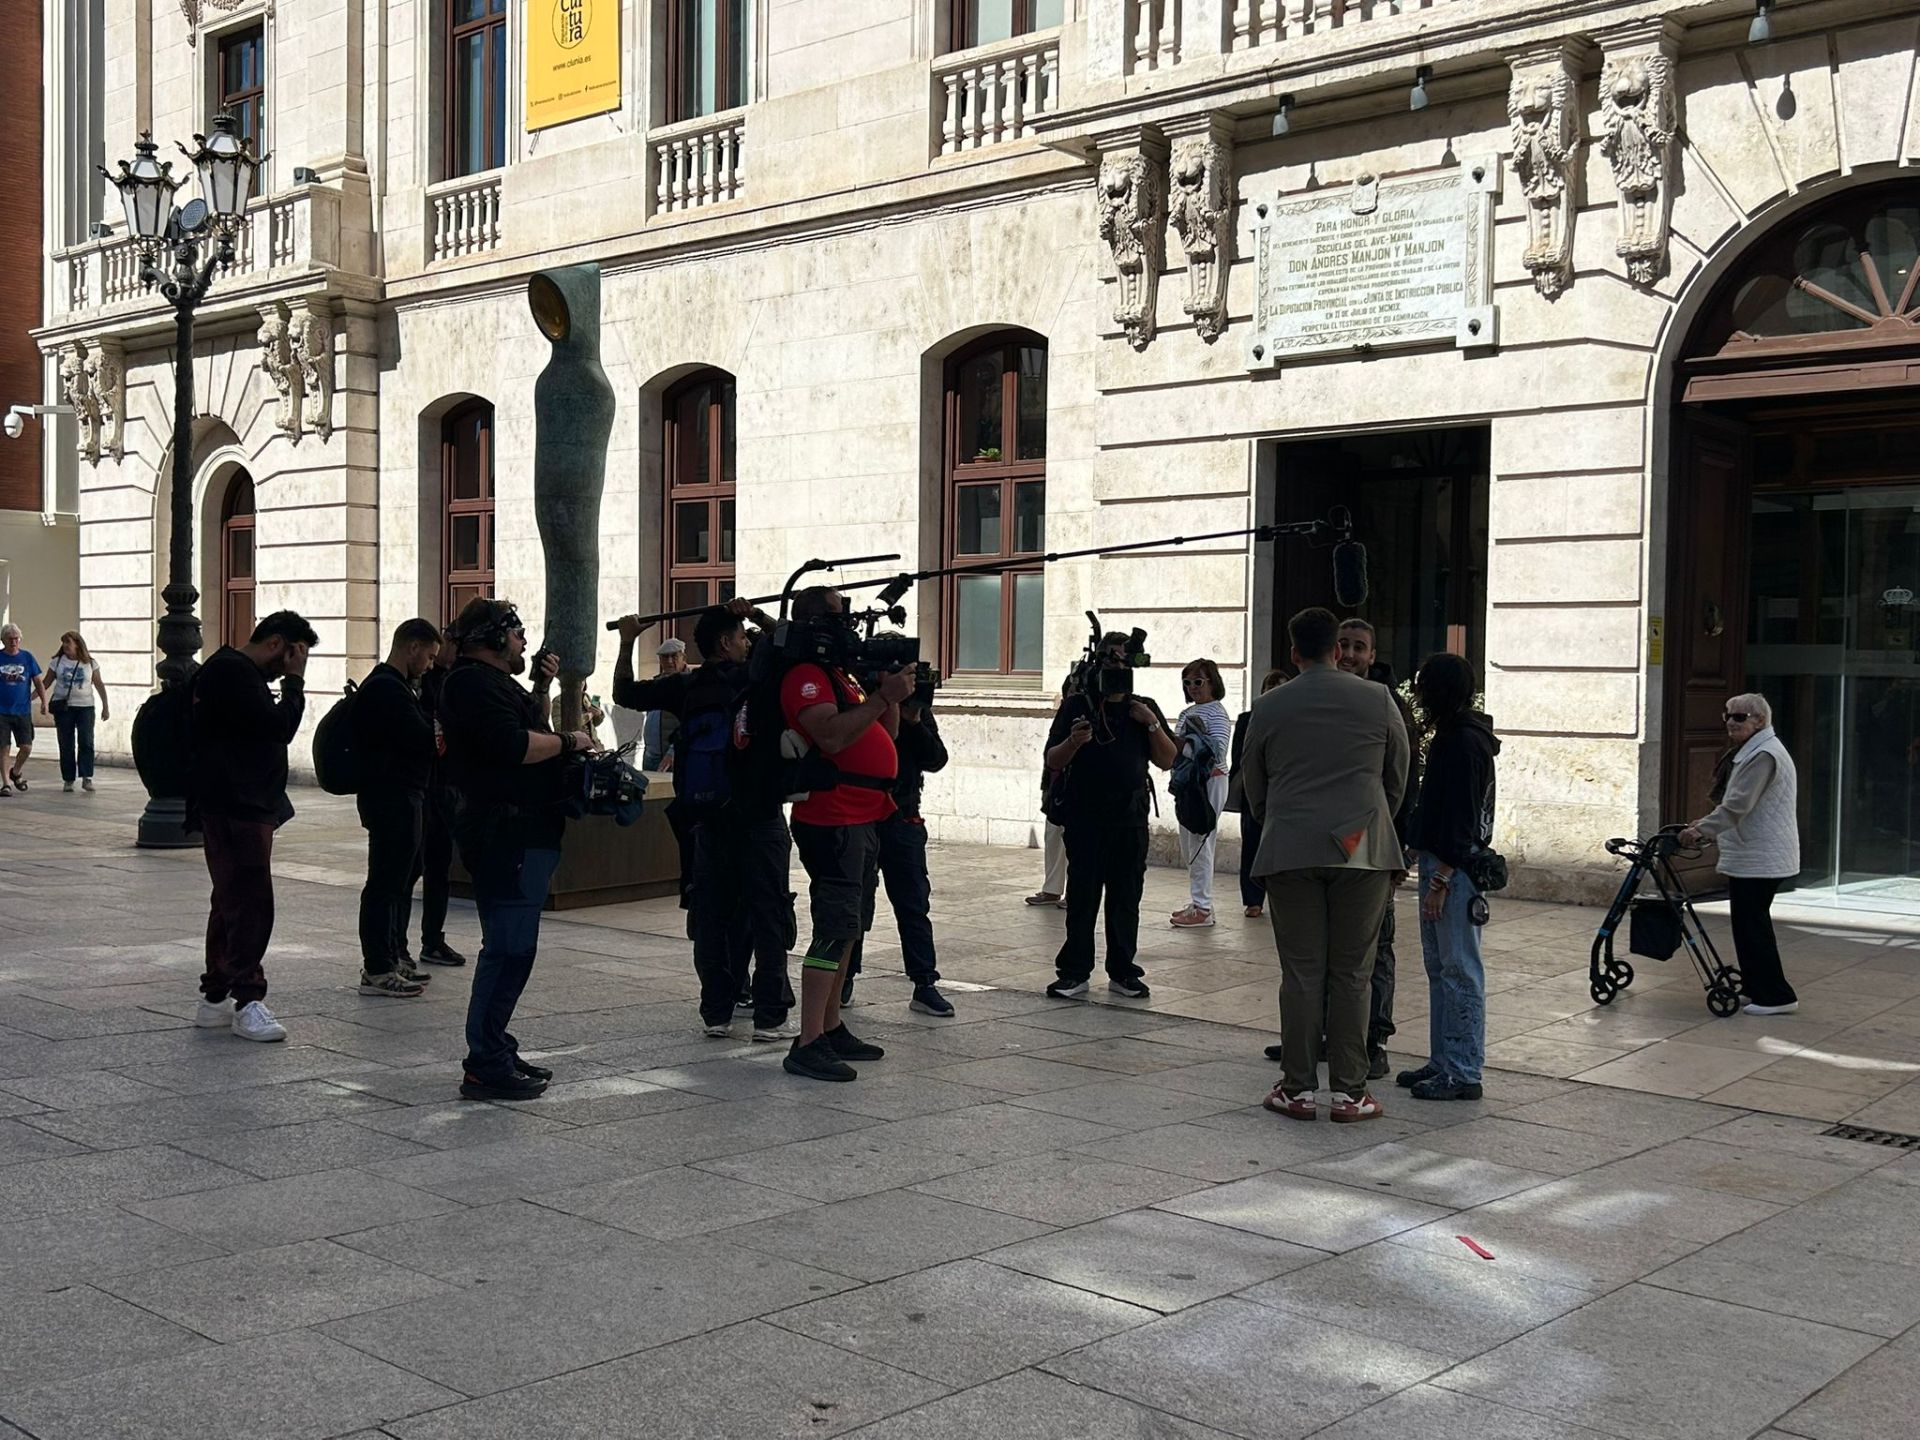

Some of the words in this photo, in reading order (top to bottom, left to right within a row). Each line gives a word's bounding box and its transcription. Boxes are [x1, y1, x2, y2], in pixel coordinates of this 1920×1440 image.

[569, 11, 582, 27] tu
[569, 25, 582, 42] ra
[1316, 222, 1337, 233] PARA
[1341, 217, 1370, 229] HONOR
[1374, 214, 1379, 224] Y
[1383, 210, 1414, 223] GLORIA
[1317, 241, 1352, 254] ESCUELAS
[1355, 238, 1368, 248] DEL
[1289, 260, 1308, 273] DON
[1311, 254, 1348, 270] ANDRES
[1352, 248, 1390, 264] MANJON
[1395, 245, 1400, 257] Y
[1405, 240, 1444, 256] MANJON
[1270, 305, 1277, 316] LA
[1314, 297, 1347, 311] PROVINCIAL
[1364, 292, 1384, 304] JUNTA
[1386, 289, 1393, 301] DE
